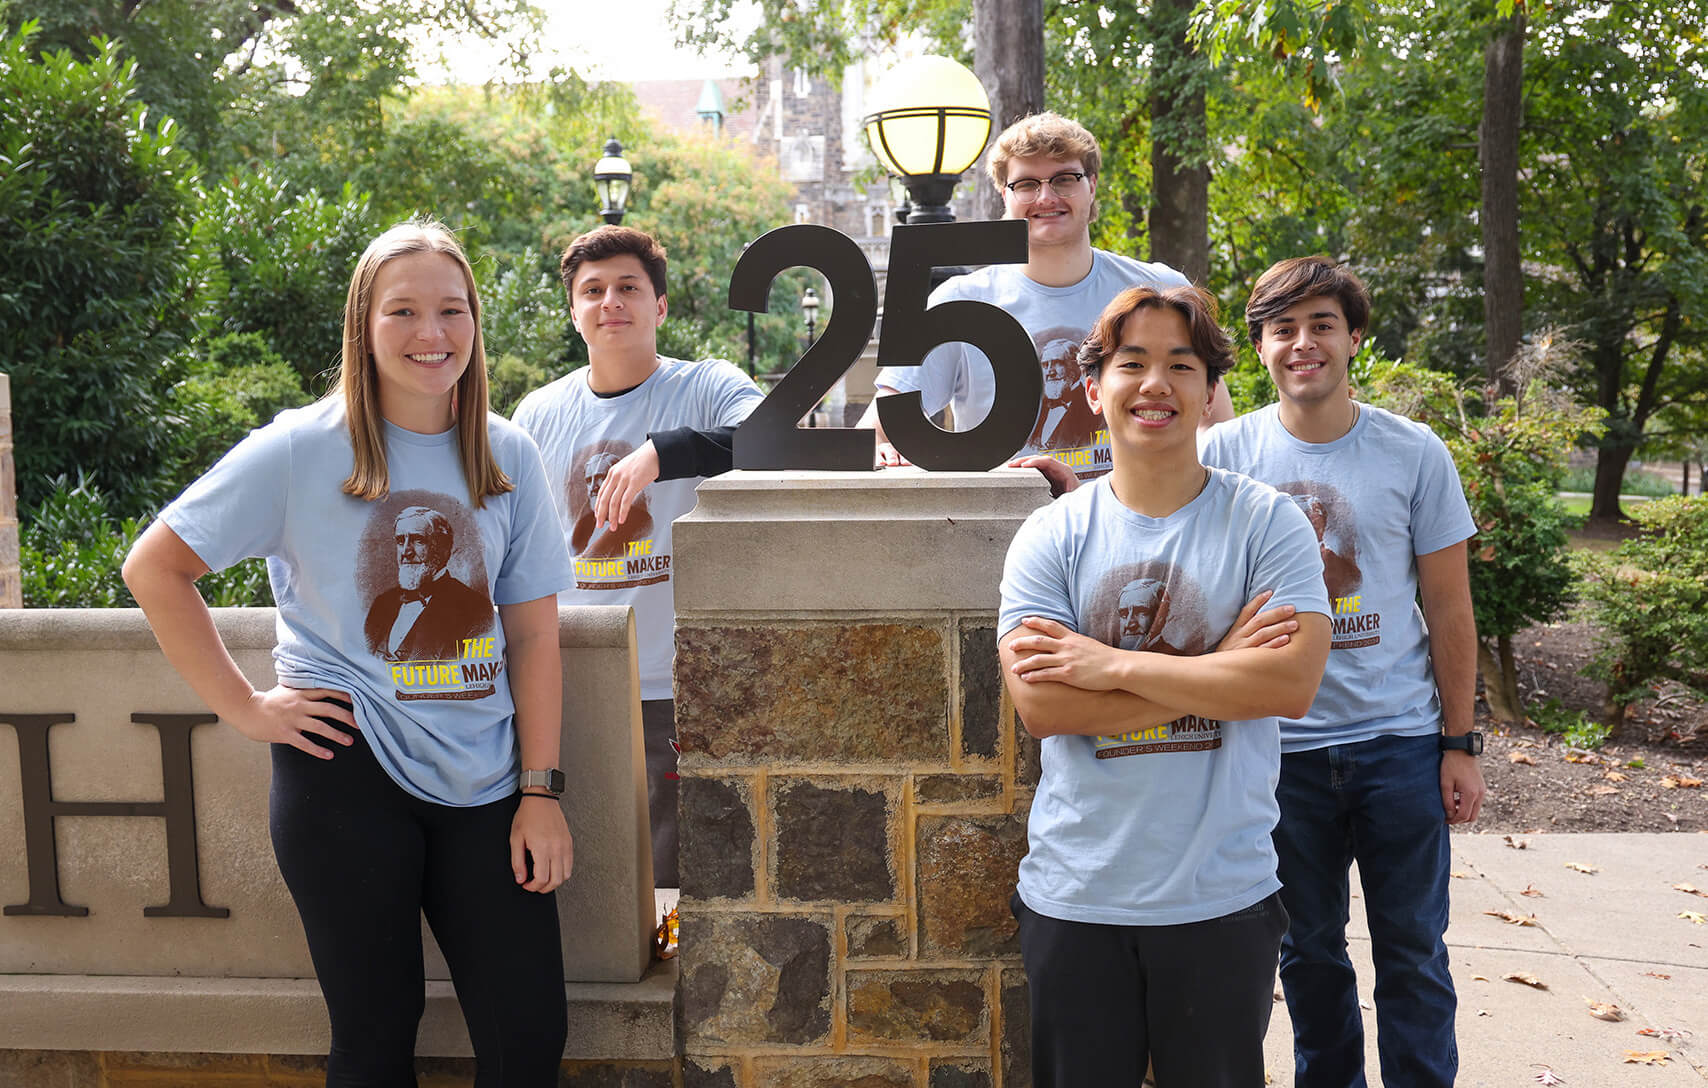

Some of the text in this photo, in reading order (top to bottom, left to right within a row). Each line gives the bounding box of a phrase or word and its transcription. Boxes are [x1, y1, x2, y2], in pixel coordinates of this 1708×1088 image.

[728, 219, 1044, 472] 25
[1095, 429, 1111, 446] TH
[628, 539, 654, 557] THE
[575, 560, 625, 577] FUTURE
[626, 555, 671, 575] MAKER
[1335, 596, 1361, 614] THE
[1333, 613, 1380, 635] MAKER
[462, 637, 496, 659] THE
[391, 660, 504, 686] FUTURE MAK
[1155, 741, 1203, 753] WEEKEND
[0, 712, 231, 918] H
